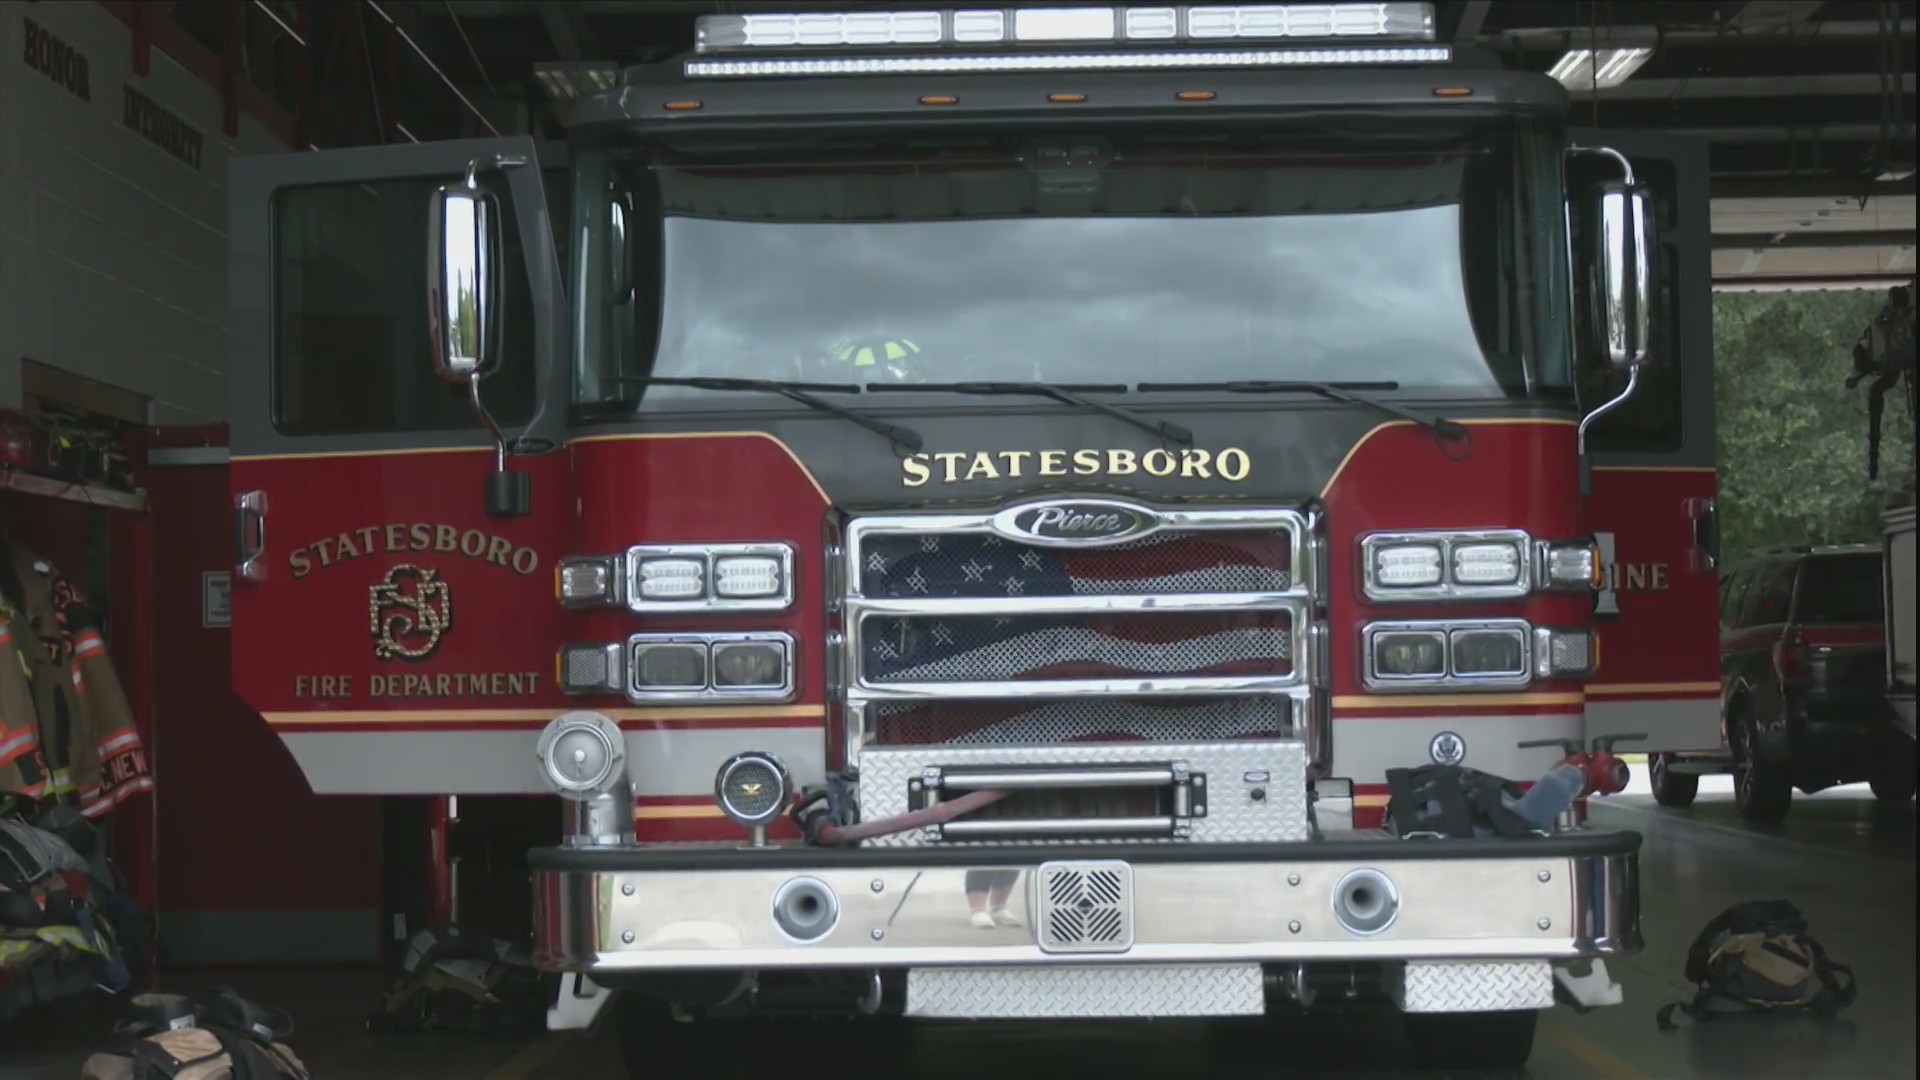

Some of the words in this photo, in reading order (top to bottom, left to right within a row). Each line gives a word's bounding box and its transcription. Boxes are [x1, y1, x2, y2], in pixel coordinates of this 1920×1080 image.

[24, 16, 91, 102] HONOR
[903, 447, 1251, 487] STATESBORO
[1030, 505, 1123, 535] Pierce
[288, 522, 539, 579] STATESBORO
[1602, 562, 1669, 590] INE
[295, 674, 353, 698] FIRE
[369, 671, 540, 697] DEPARTMENT
